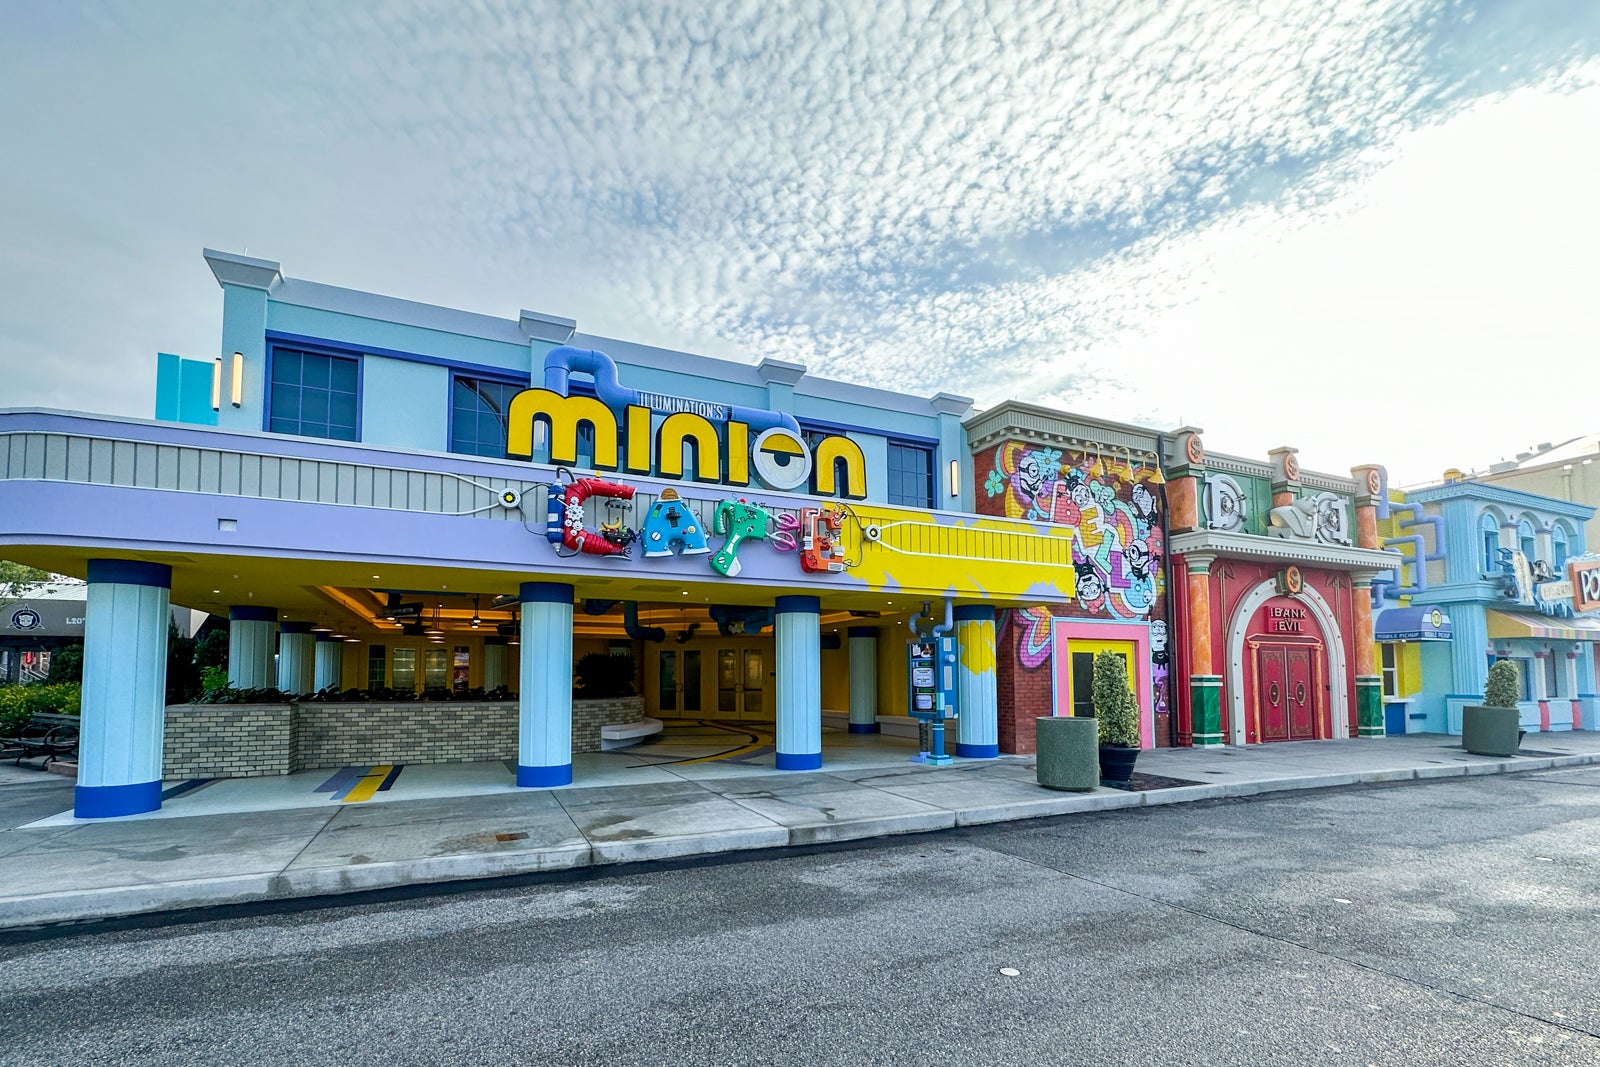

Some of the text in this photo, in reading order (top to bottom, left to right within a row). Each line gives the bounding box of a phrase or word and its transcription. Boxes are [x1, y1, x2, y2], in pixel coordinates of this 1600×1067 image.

[640, 391, 723, 419] ILLUMINATION'S
[1053, 483, 1152, 609] BELLO
[1270, 608, 1306, 618] BANK
[1275, 621, 1304, 632] EVIL
